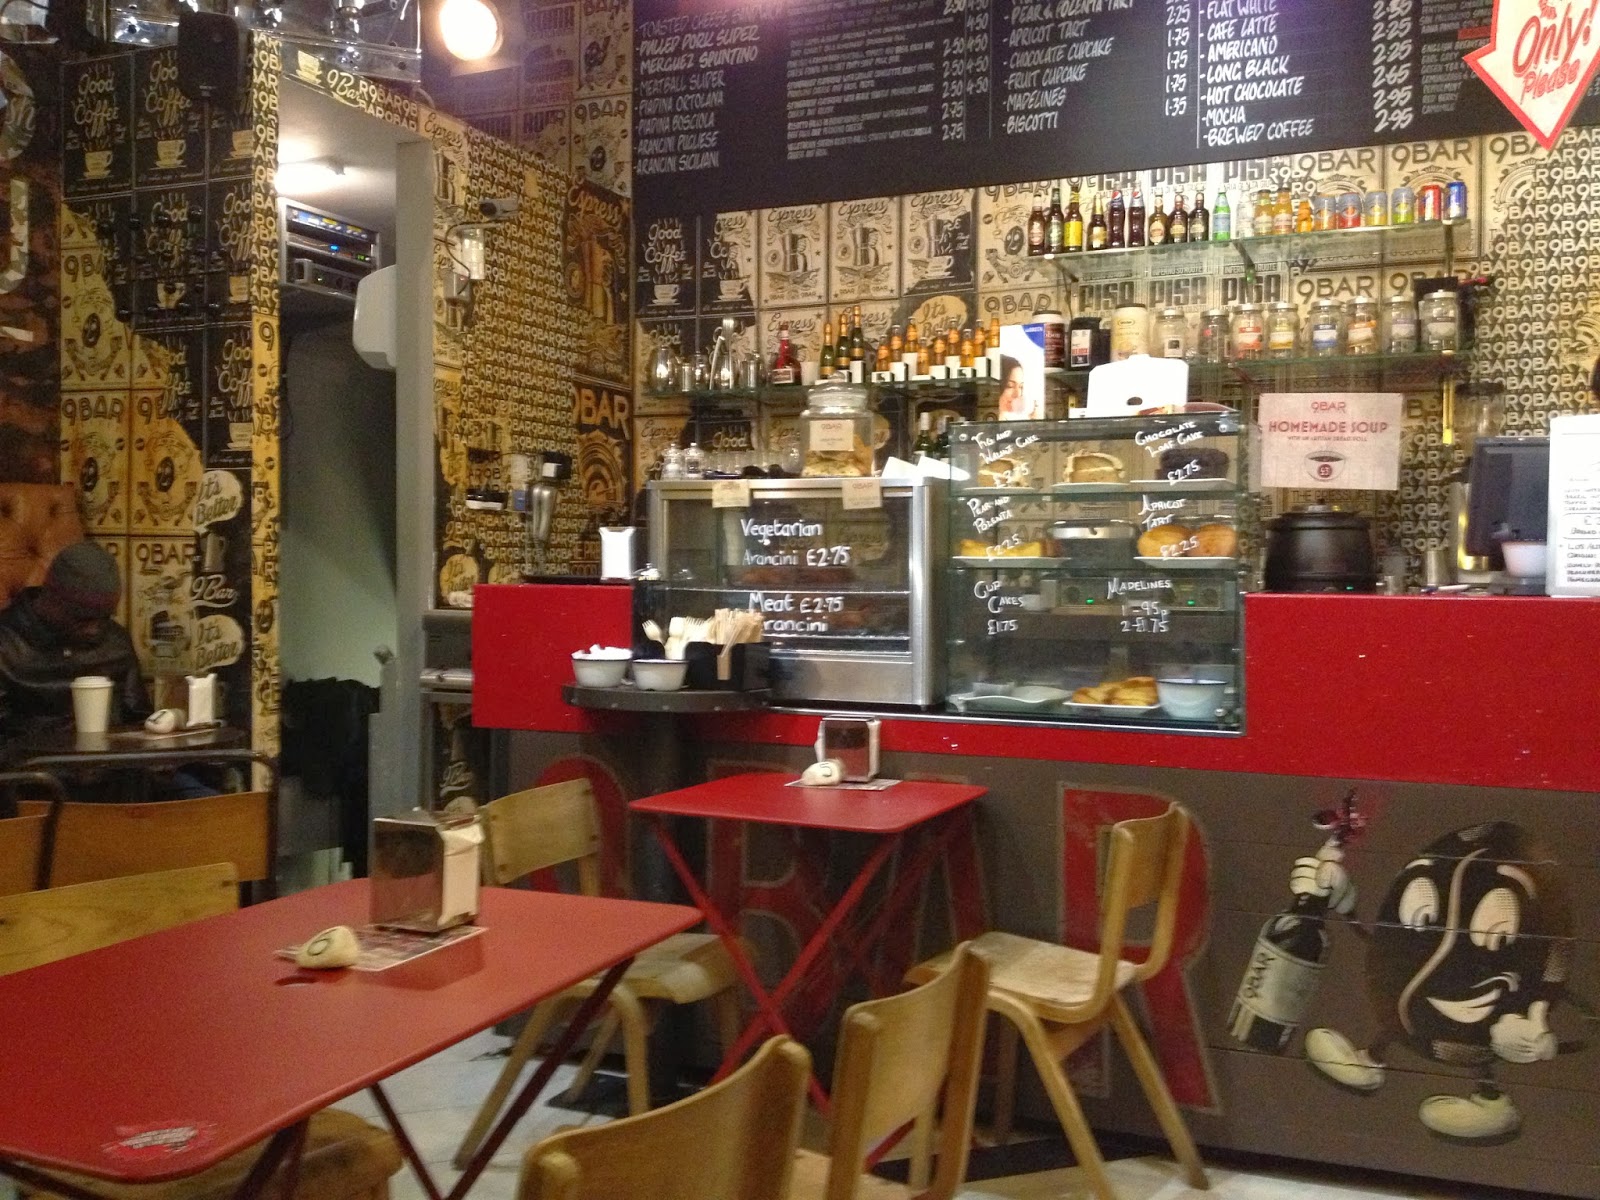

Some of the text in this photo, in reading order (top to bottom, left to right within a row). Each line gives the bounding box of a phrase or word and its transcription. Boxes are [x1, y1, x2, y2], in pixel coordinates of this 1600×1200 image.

[1011, 4, 1043, 25] PEAR
[1166, 4, 1190, 26] 2.25
[1207, 0, 1237, 19] FLAT
[1009, 19, 1091, 47] APRICOT TART
[1167, 27, 1190, 47] 1.75
[1207, 12, 1280, 42] CAFE LATTE
[1371, 17, 1412, 41] 2.25
[1009, 36, 1115, 69] CHOCOLATE CUPCAKE
[1166, 49, 1188, 70] 1.75
[1207, 35, 1278, 63] AMERICANO
[1372, 39, 1412, 66] 2.25
[1007, 62, 1088, 90] FRUIT CUPCAKE
[1206, 55, 1290, 84] LONG BLACK
[1520, 59, 1580, 105] Please
[1165, 73, 1187, 93] 1.75
[1206, 76, 1305, 106] HOT CHOCOLATE
[1164, 96, 1187, 116] 1.35
[1373, 85, 1413, 110] 2.95
[1006, 111, 1058, 135] BISCOTTI
[1205, 105, 1246, 127] MOCHA
[1374, 107, 1414, 133] 2.95
[1207, 118, 1315, 147] BREWED COFFEE
[1298, 148, 1376, 177] 9BAR
[1391, 139, 1472, 171] 9BAR
[645, 243, 687, 274] Coffee
[1297, 275, 1375, 304] 9BAR
[1311, 401, 1347, 414] 9BAR
[1135, 421, 1197, 446] CHOCOLATE
[1268, 420, 1388, 433] HOMEMADE SOUP
[740, 518, 824, 545] Vegetarian
[743, 549, 799, 566] Arancini
[748, 591, 795, 613] Meat
[762, 616, 829, 632] rancini
